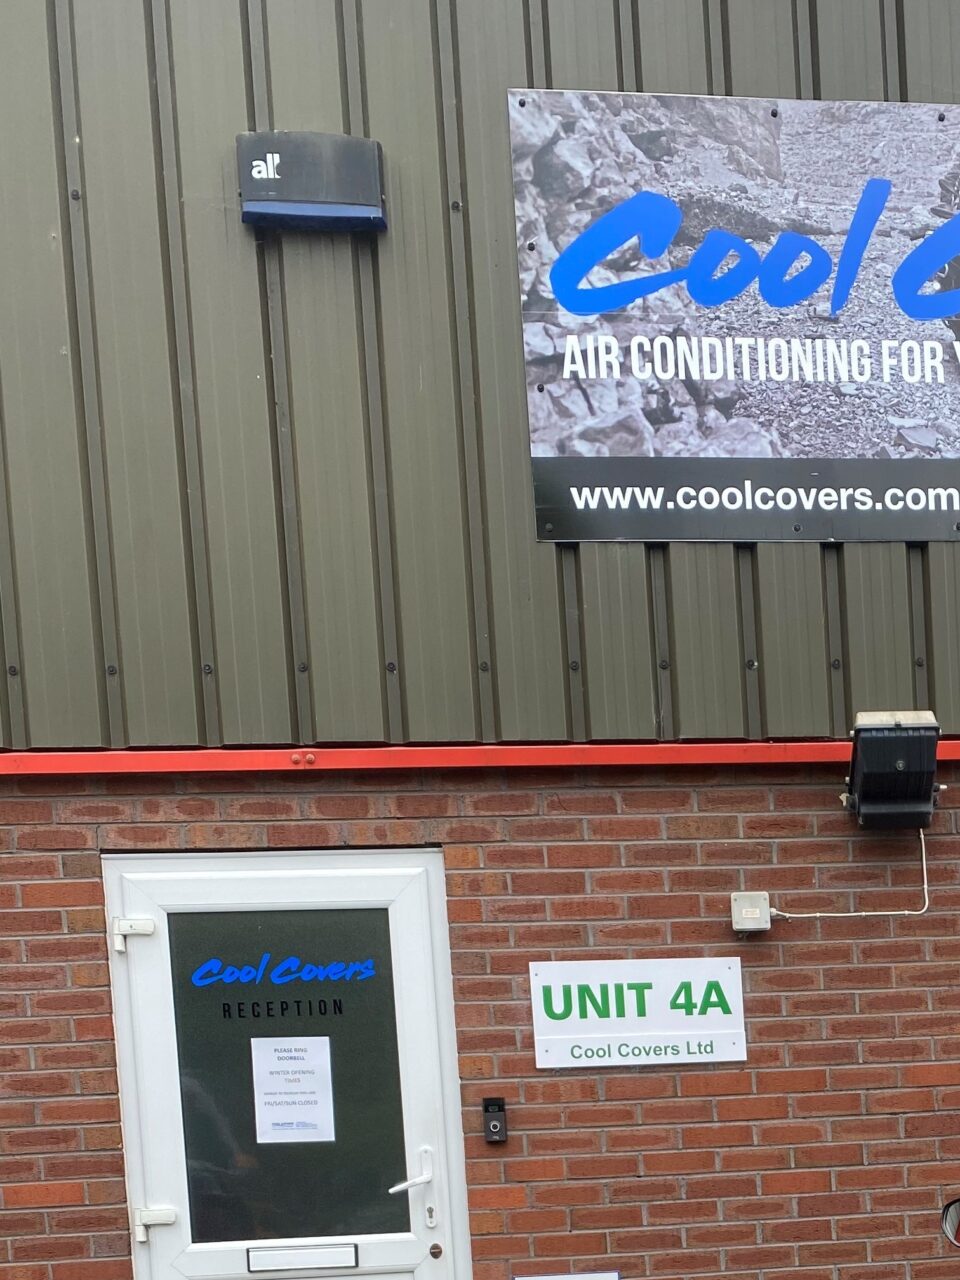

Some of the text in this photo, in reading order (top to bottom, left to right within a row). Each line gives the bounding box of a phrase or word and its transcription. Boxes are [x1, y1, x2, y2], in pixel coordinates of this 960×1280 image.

[549, 178, 892, 317] Cool
[562, 333, 621, 380] AIR
[630, 334, 873, 384] CONDITIONING
[882, 338, 945, 384] FOR
[569, 480, 960, 512] www.coolcovers.com
[191, 952, 376, 987] Cool Covers
[222, 999, 344, 1019] RECEPTION
[541, 980, 733, 1021] UNIT 4A
[570, 1040, 714, 1059] Cool Covers Ltd
